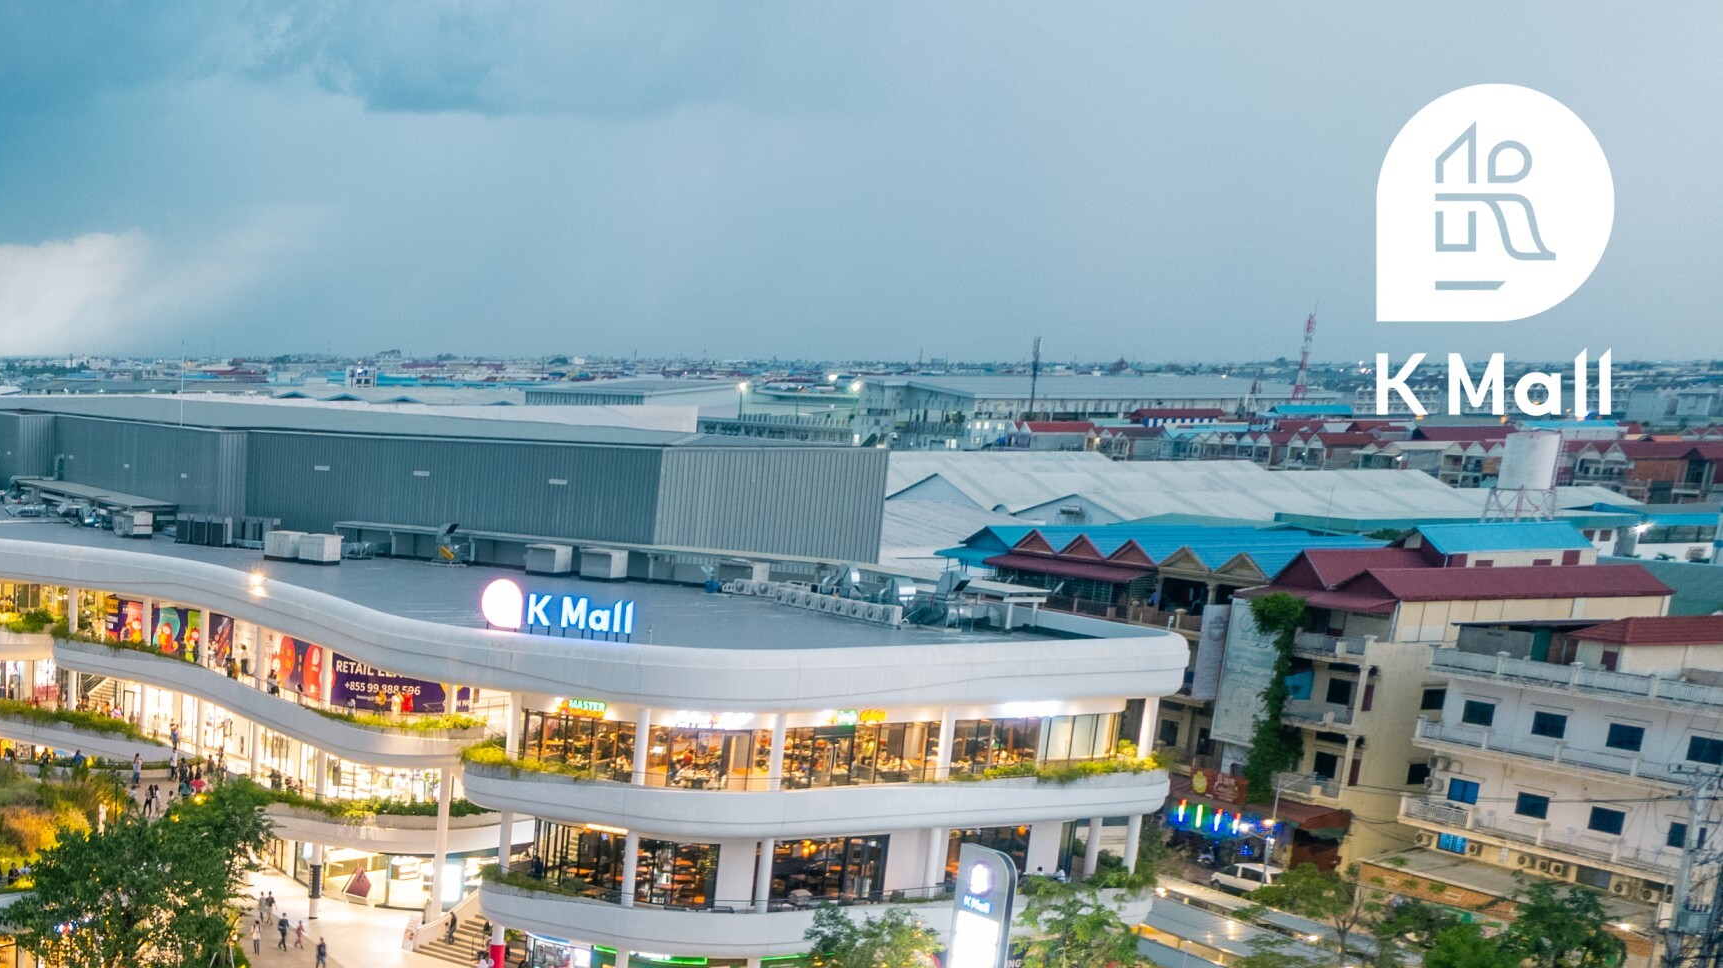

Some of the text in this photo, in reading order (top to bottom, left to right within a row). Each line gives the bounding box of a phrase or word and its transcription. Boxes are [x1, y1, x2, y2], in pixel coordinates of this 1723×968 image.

[527, 593, 635, 634] K Mall
[336, 659, 374, 677] RETAIL
[344, 681, 366, 692] +855
[367, 683, 379, 693] 99
[569, 699, 605, 712] MASTER
